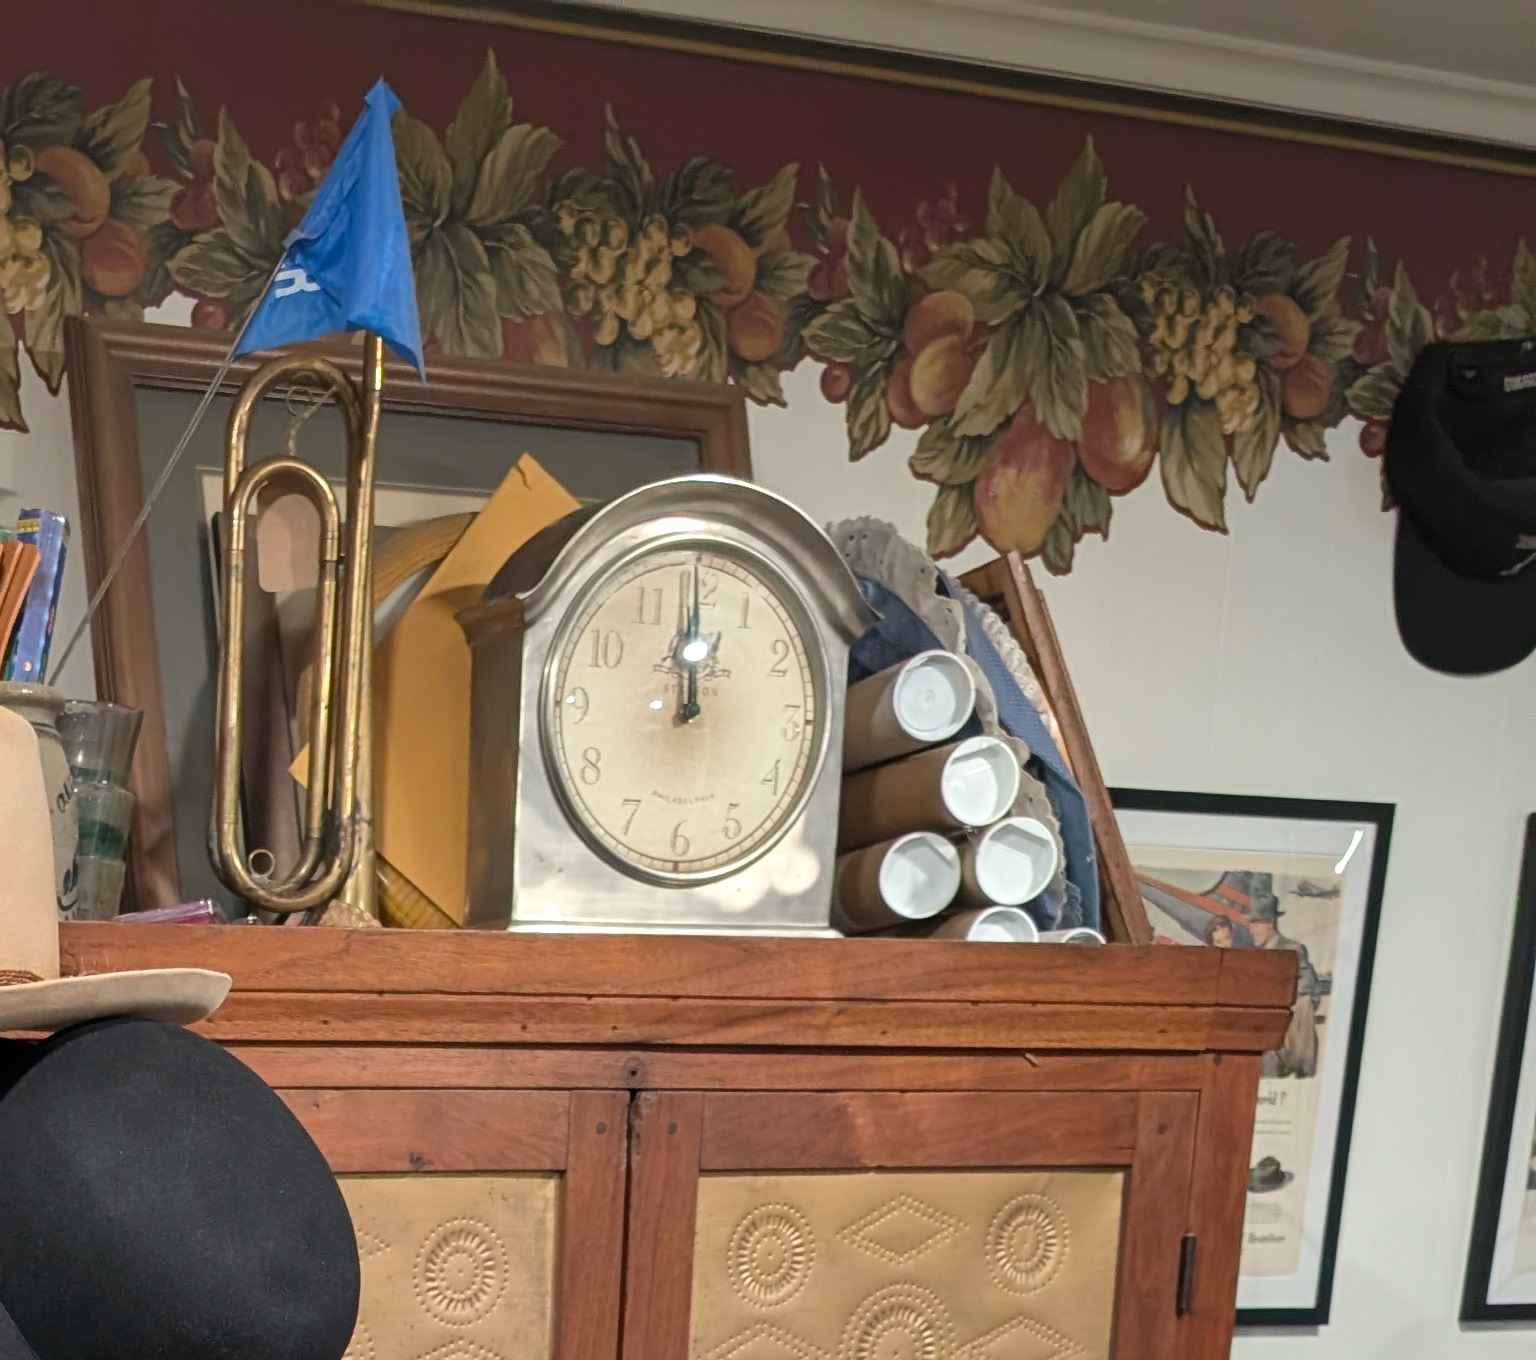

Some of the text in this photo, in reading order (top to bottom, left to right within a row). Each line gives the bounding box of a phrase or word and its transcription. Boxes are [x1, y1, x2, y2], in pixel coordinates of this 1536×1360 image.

[632, 586, 663, 626] 11
[737, 591, 752, 629] 1
[589, 629, 624, 669] 10
[768, 639, 790, 678] 2
[565, 686, 590, 725] 9
[663, 683, 719, 697] STON
[780, 703, 802, 742] 3
[580, 747, 601, 785] 8
[760, 758, 782, 797] 4
[621, 798, 643, 836] 7
[721, 802, 742, 840] 5
[670, 819, 691, 858] 6
